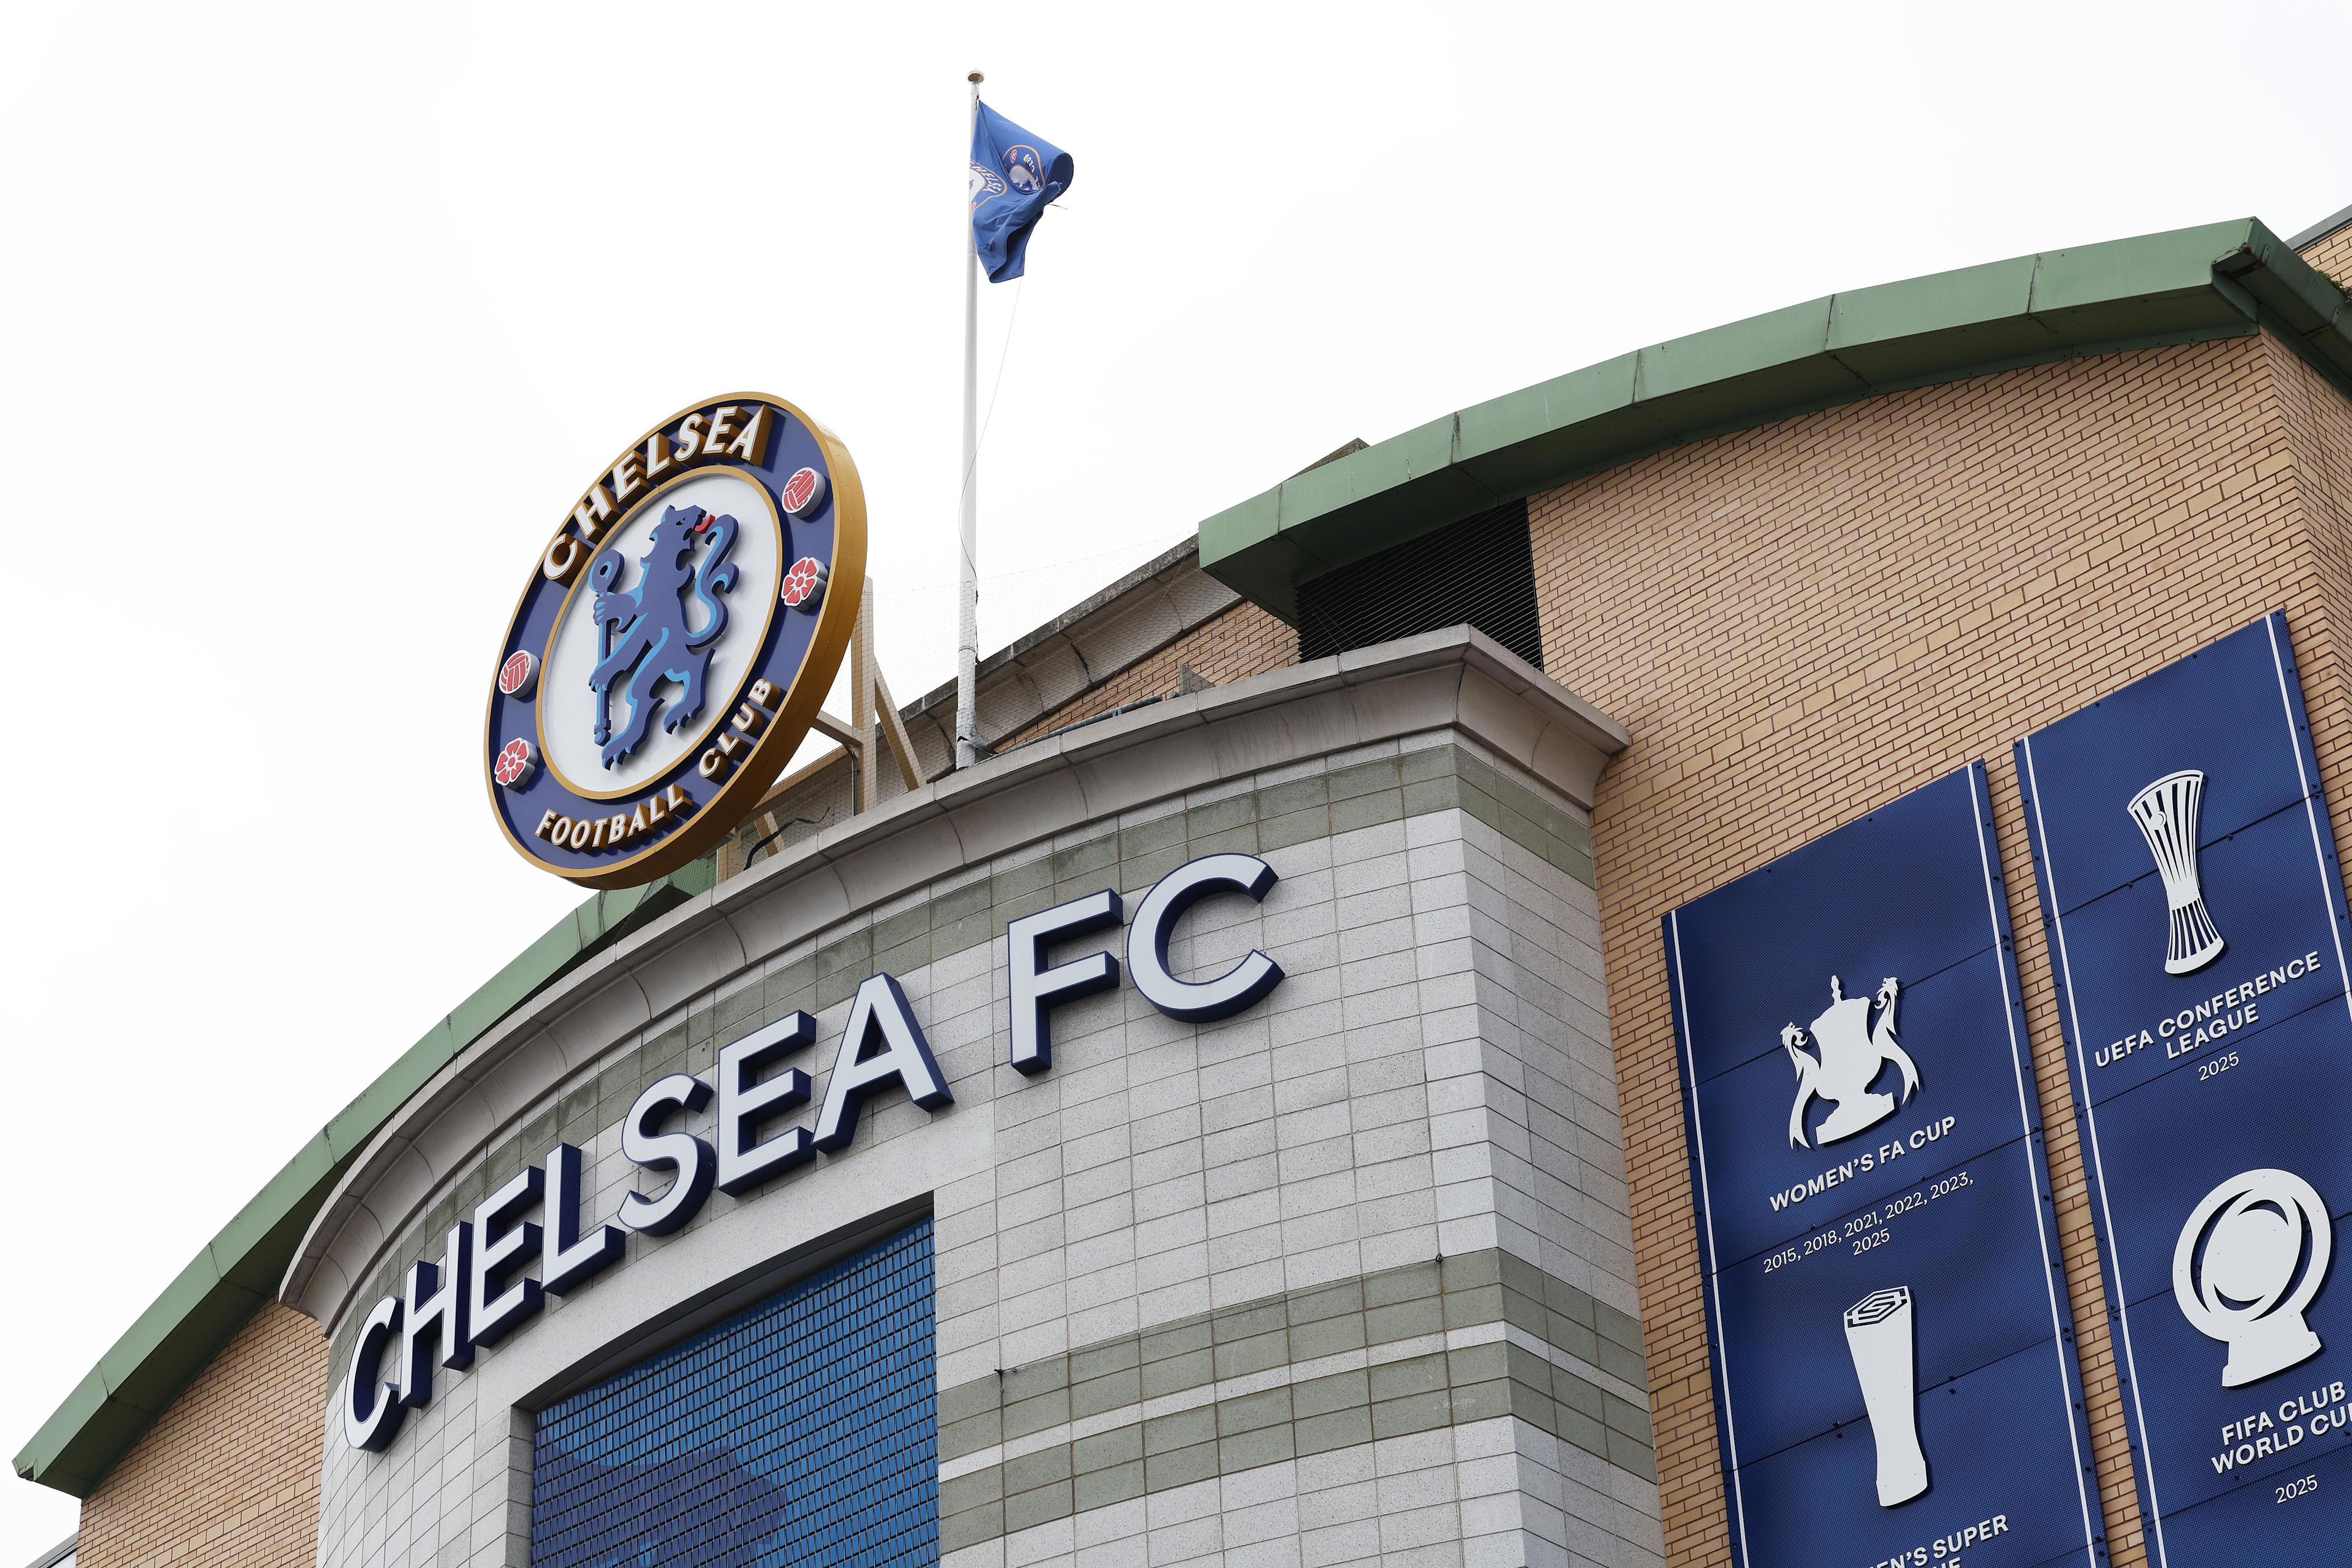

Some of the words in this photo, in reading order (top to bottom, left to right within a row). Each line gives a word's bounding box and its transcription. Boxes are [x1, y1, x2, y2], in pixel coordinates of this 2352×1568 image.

[542, 404, 782, 582] CHELSEA
[534, 784, 689, 851] FOOTBALL
[699, 677, 778, 780] CLUB
[2094, 1029, 2155, 1068] UEFA
[2158, 950, 2322, 1038] CONFERENCE
[2166, 1003, 2260, 1060] LEAGUE
[2198, 1051, 2240, 1081] 2025
[343, 971, 954, 1453] CHELSEA
[1008, 852, 1285, 1077] FC
[1879, 1140, 1906, 1165] FA
[1909, 1116, 1957, 1150] CUP
[1763, 1247, 1802, 1274] 2015,
[1803, 1229, 1843, 1256] 2018,
[1844, 1211, 1883, 1238] 2021,
[1885, 1191, 1928, 1220] 2022,
[1929, 1170, 1975, 1200] 2023,
[1852, 1227, 1891, 1257] 2025
[2221, 1410, 2275, 1447] FIFA
[2278, 1381, 2346, 1422] CLUB
[2211, 1424, 2304, 1475] WORLD
[2275, 1473, 2318, 1504] 2025
[1933, 1514, 2010, 1559] SUPER
